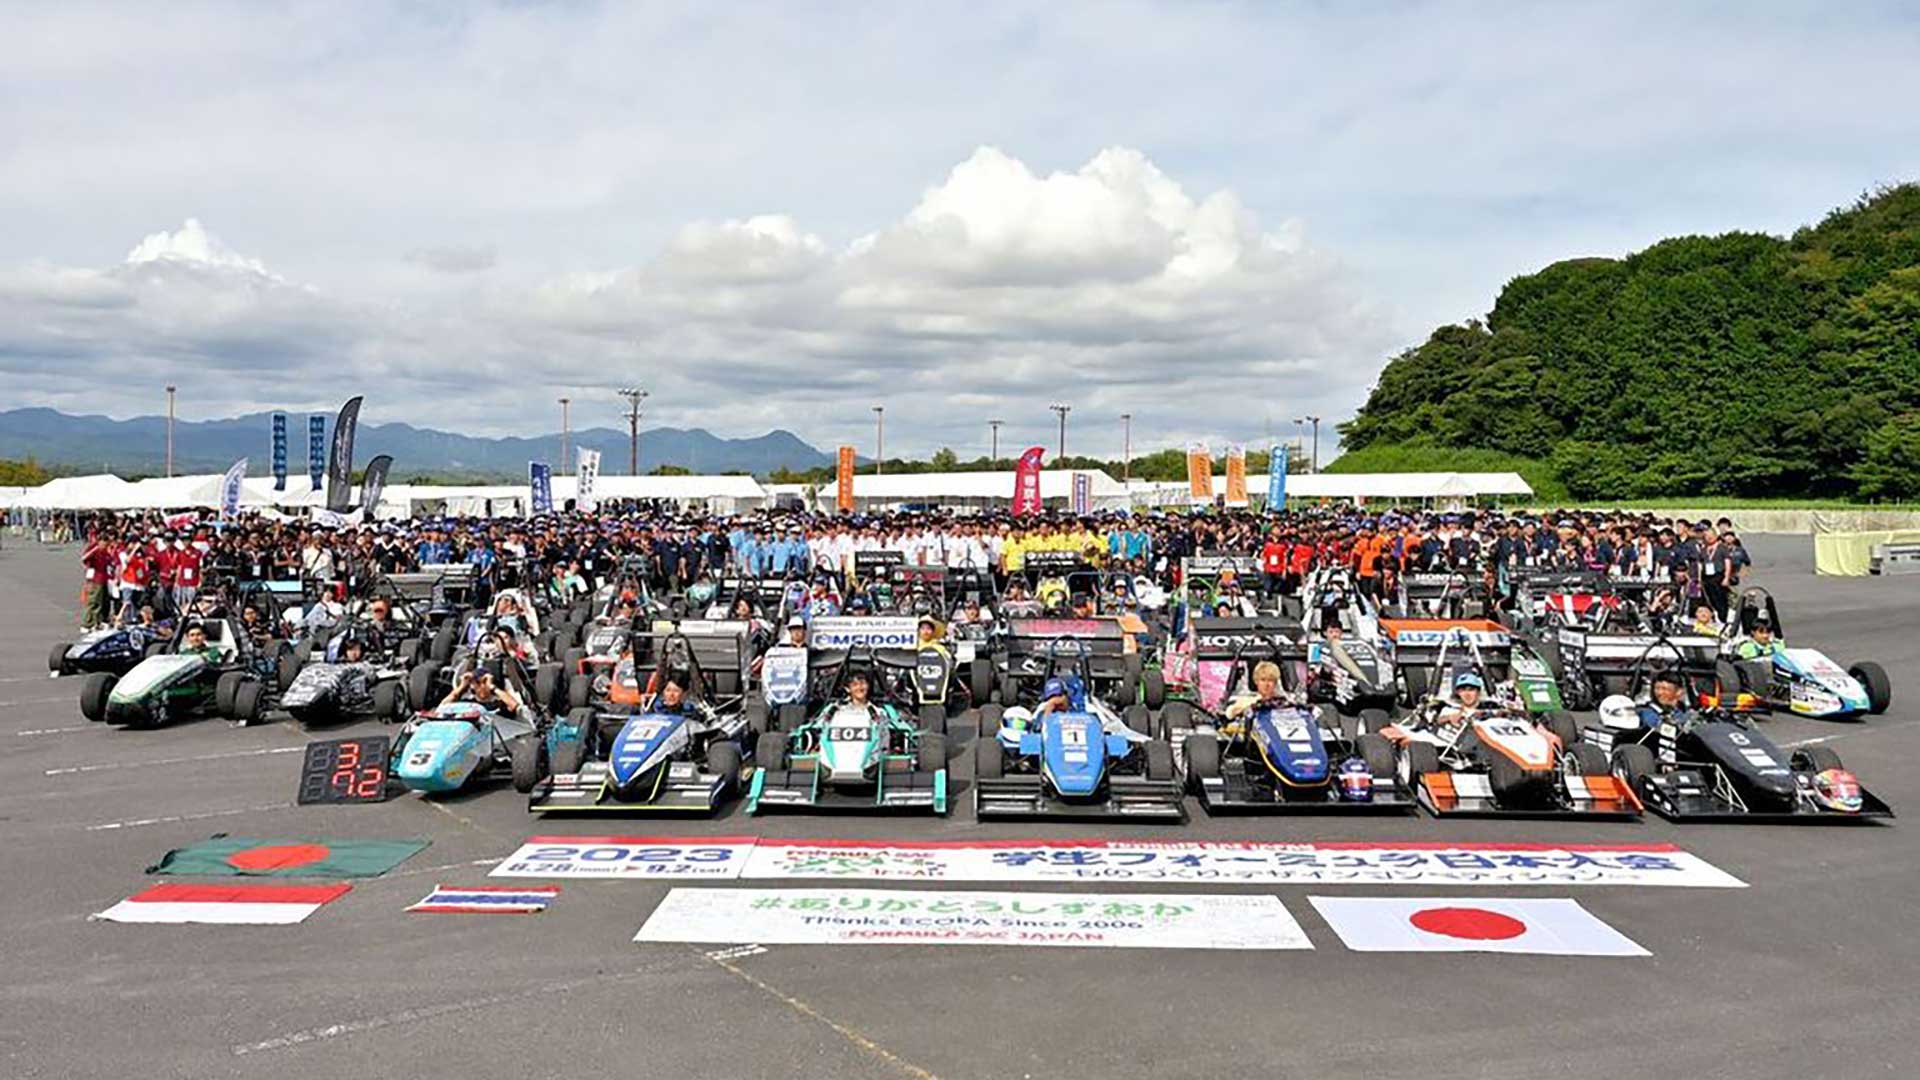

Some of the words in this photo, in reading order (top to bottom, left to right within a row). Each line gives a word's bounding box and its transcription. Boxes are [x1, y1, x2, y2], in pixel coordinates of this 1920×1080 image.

[1415, 573, 1466, 583] HONDA
[833, 634, 914, 644] MEIDOH
[831, 728, 867, 740] E04
[411, 752, 431, 765] 3
[526, 847, 733, 862] 2023
[992, 850, 1684, 871] 学生フォーミュラ日本大会
[801, 915, 890, 925] Thanks
[1078, 920, 1143, 928] 2006
[846, 929, 959, 938] FORMULA
[1017, 931, 1104, 941] JAPAN
